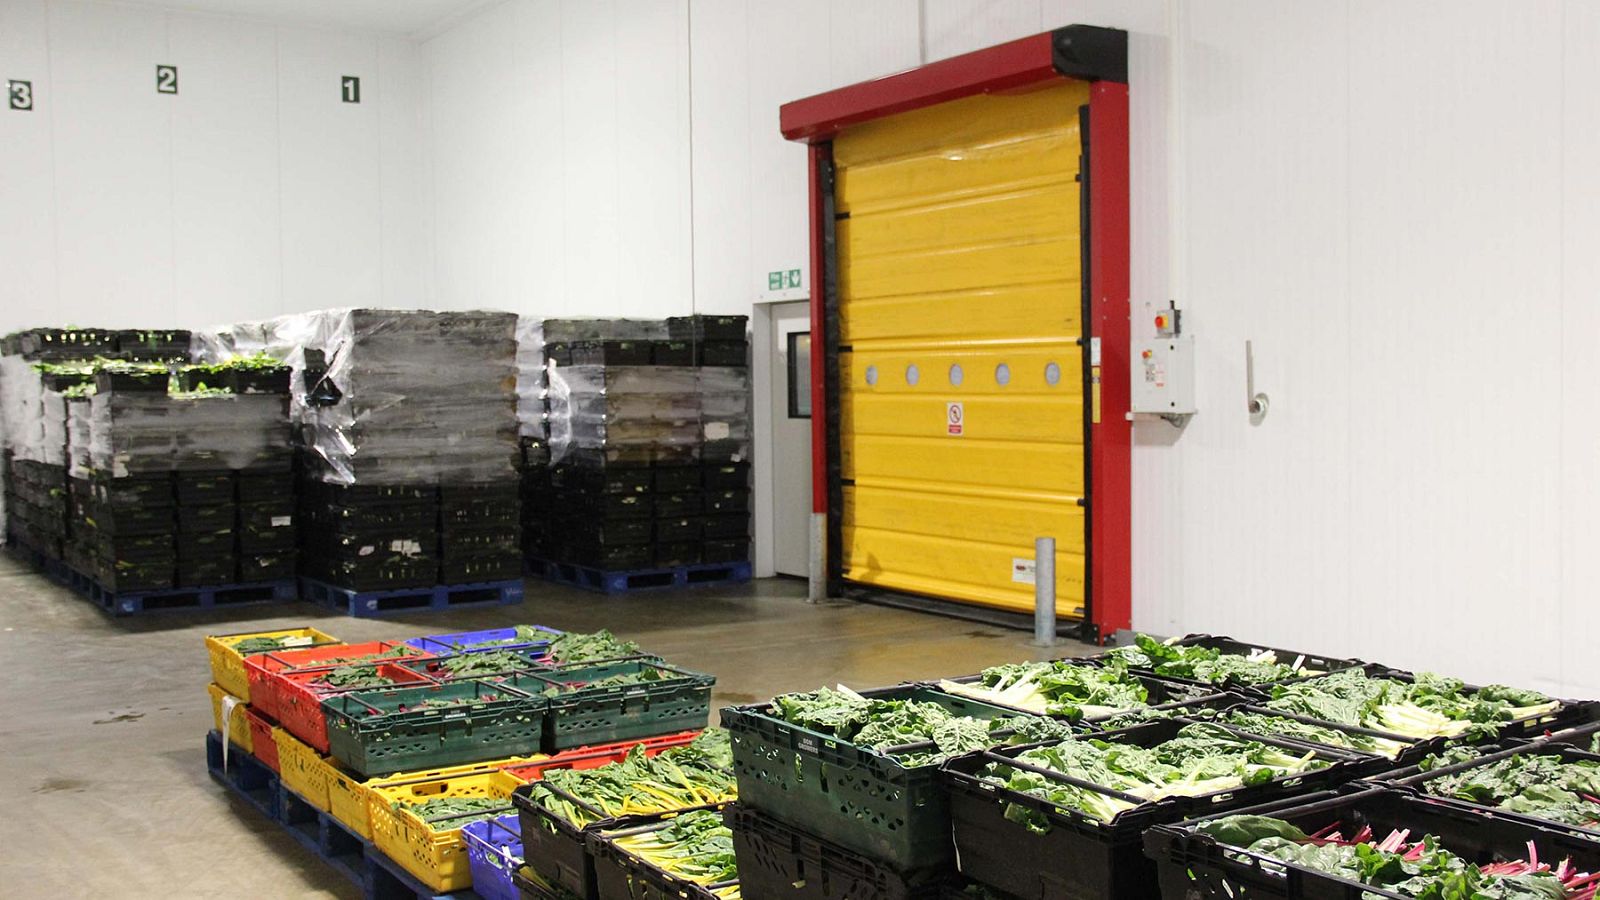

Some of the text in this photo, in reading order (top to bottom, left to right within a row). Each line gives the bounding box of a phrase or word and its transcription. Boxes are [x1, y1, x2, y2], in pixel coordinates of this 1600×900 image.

[159, 67, 175, 91] 2
[344, 79, 355, 101] 1
[12, 82, 30, 108] 3
